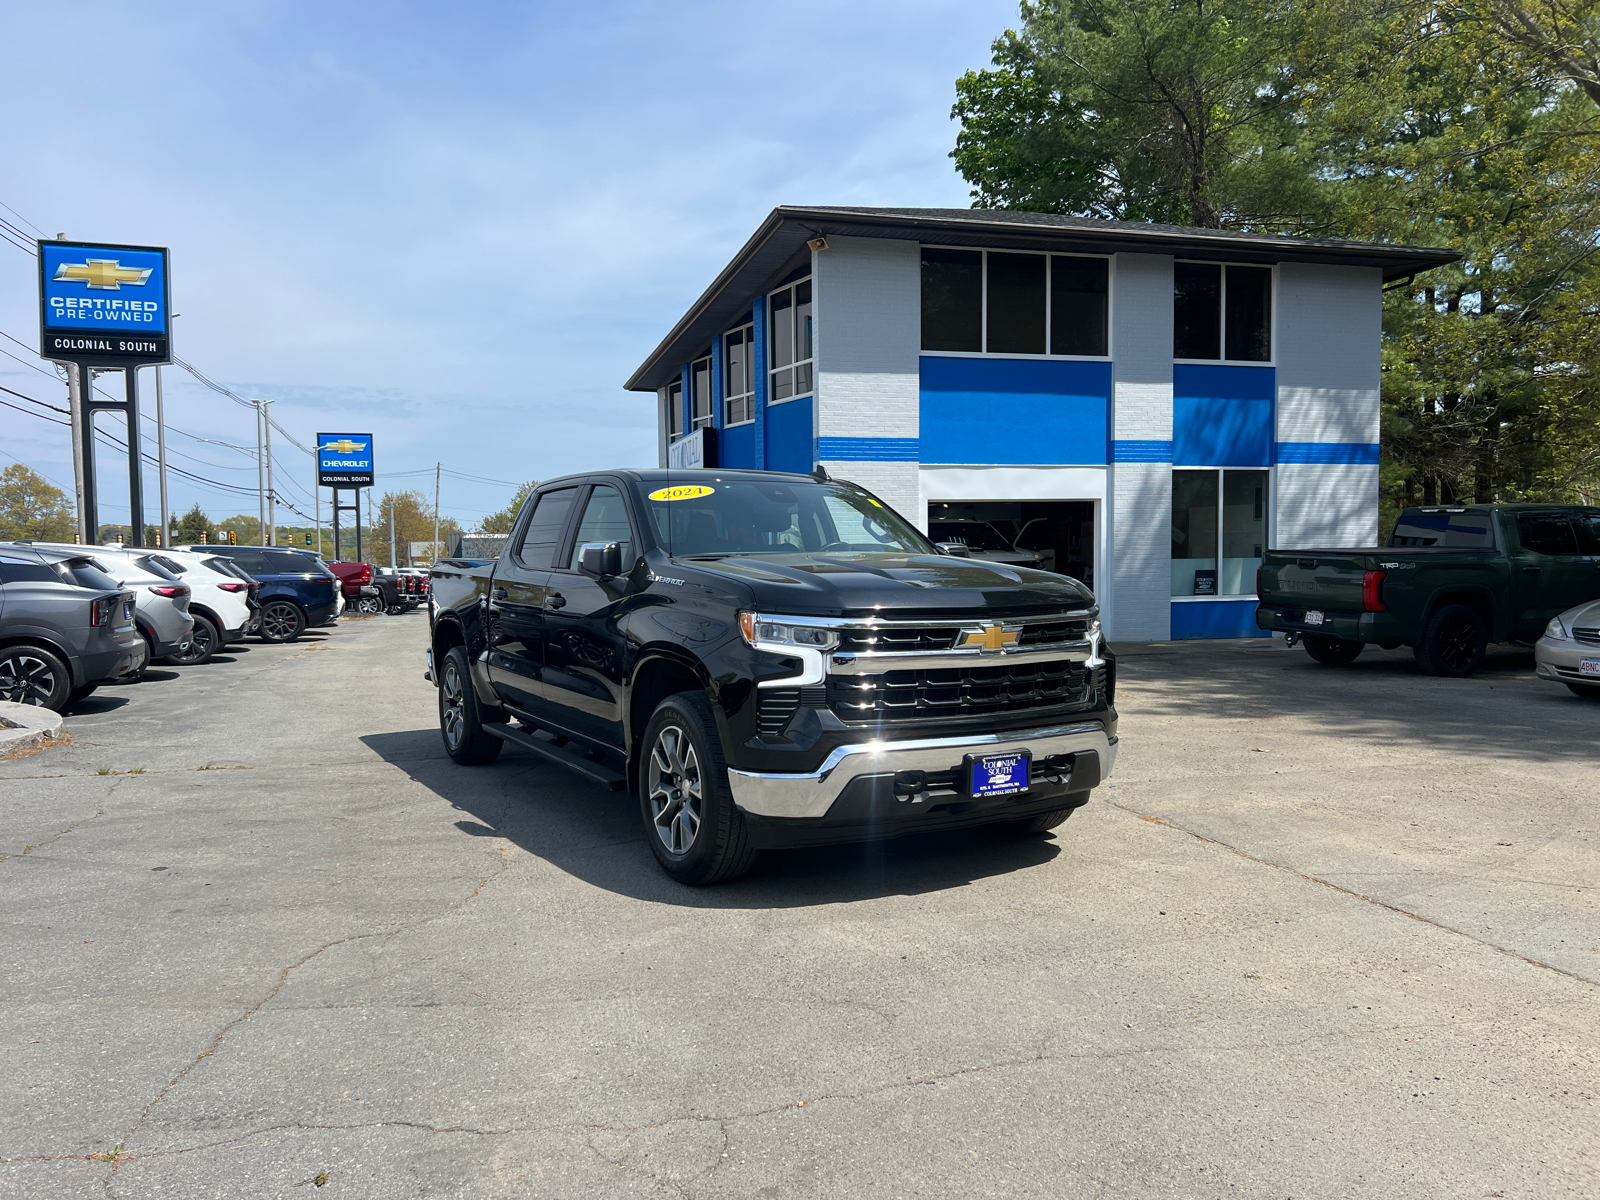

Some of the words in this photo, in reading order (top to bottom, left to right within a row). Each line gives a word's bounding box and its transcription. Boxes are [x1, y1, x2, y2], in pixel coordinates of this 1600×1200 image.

[50, 297, 158, 312] CERTIFIED
[56, 308, 153, 322] PRE-OWNED
[54, 338, 113, 350] COLONIAL
[119, 341, 157, 352] SOUTH
[662, 487, 703, 499] 2024
[1379, 562, 1399, 570] TRD
[983, 759, 1018, 769] COLONIAL
[988, 766, 1012, 776] SOUTH
